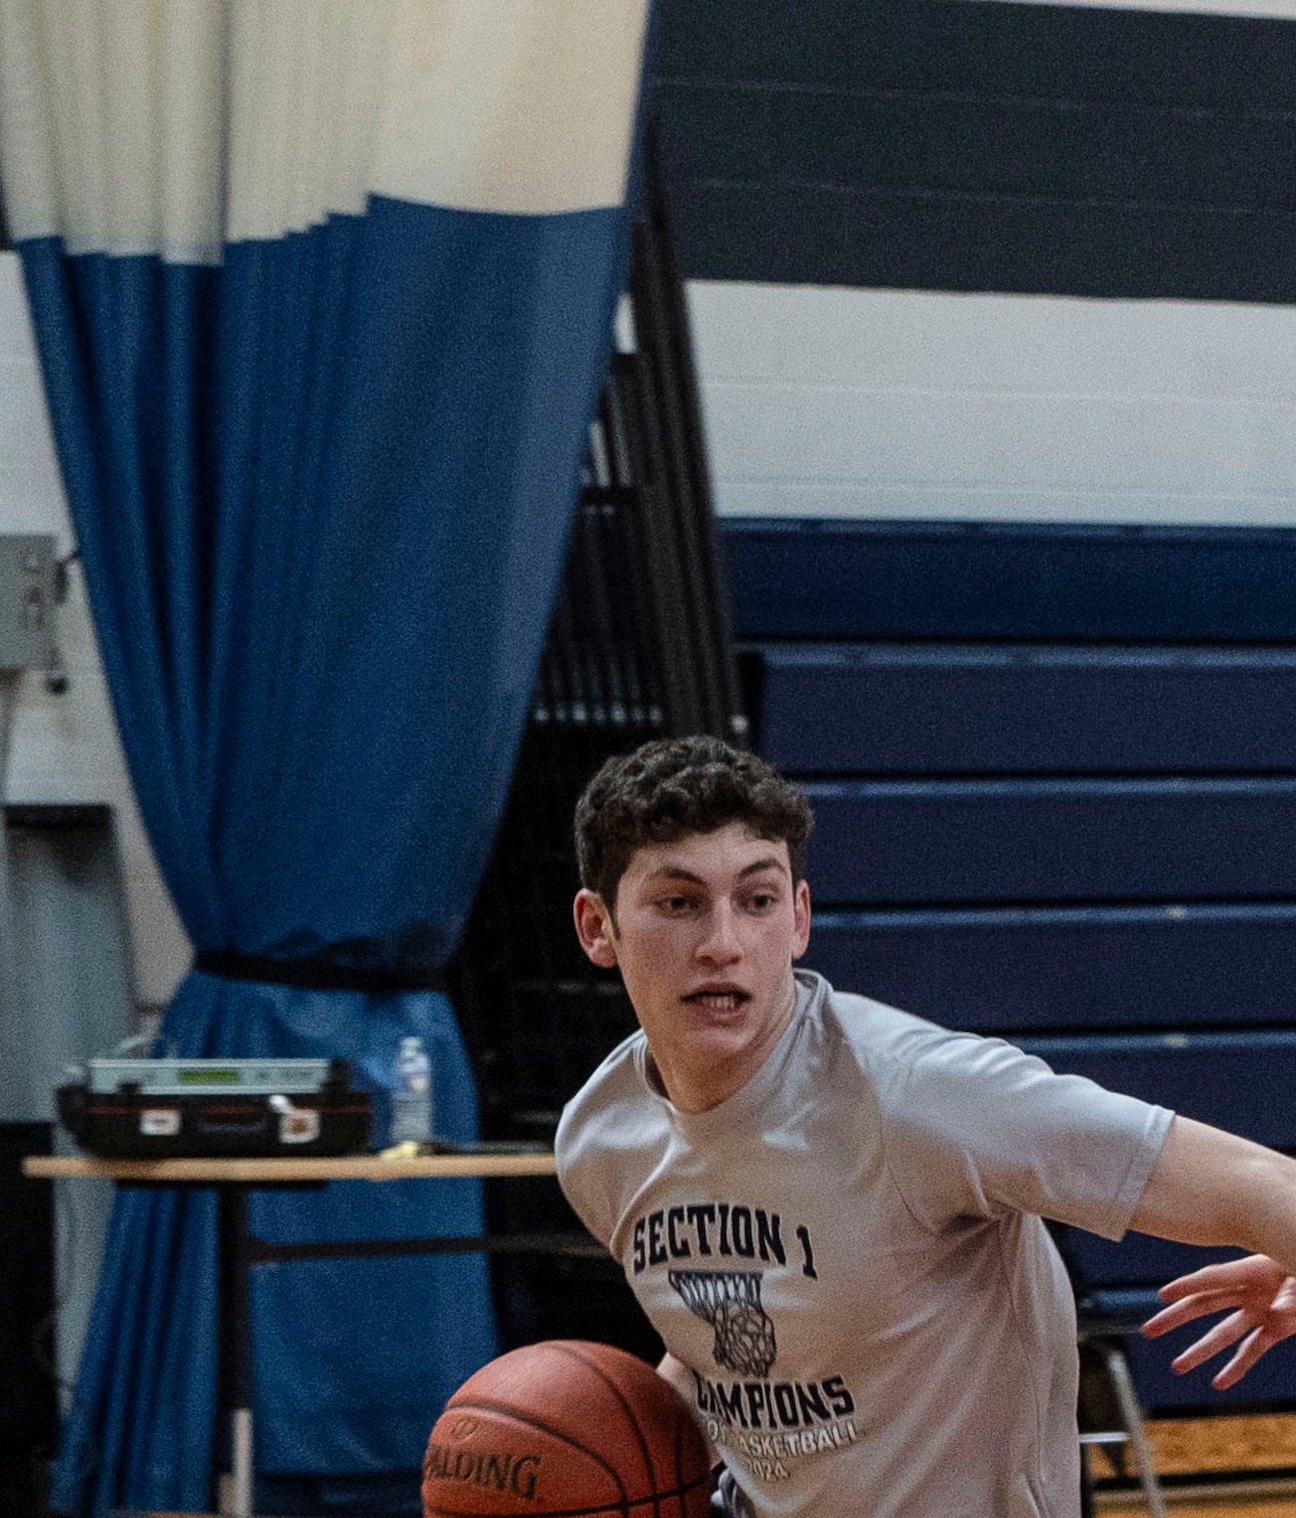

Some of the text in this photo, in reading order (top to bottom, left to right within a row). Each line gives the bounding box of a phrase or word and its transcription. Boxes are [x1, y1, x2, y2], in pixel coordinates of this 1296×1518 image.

[632, 1203, 818, 1280] SECTION 1
[739, 1418, 858, 1459] ASKETBALL
